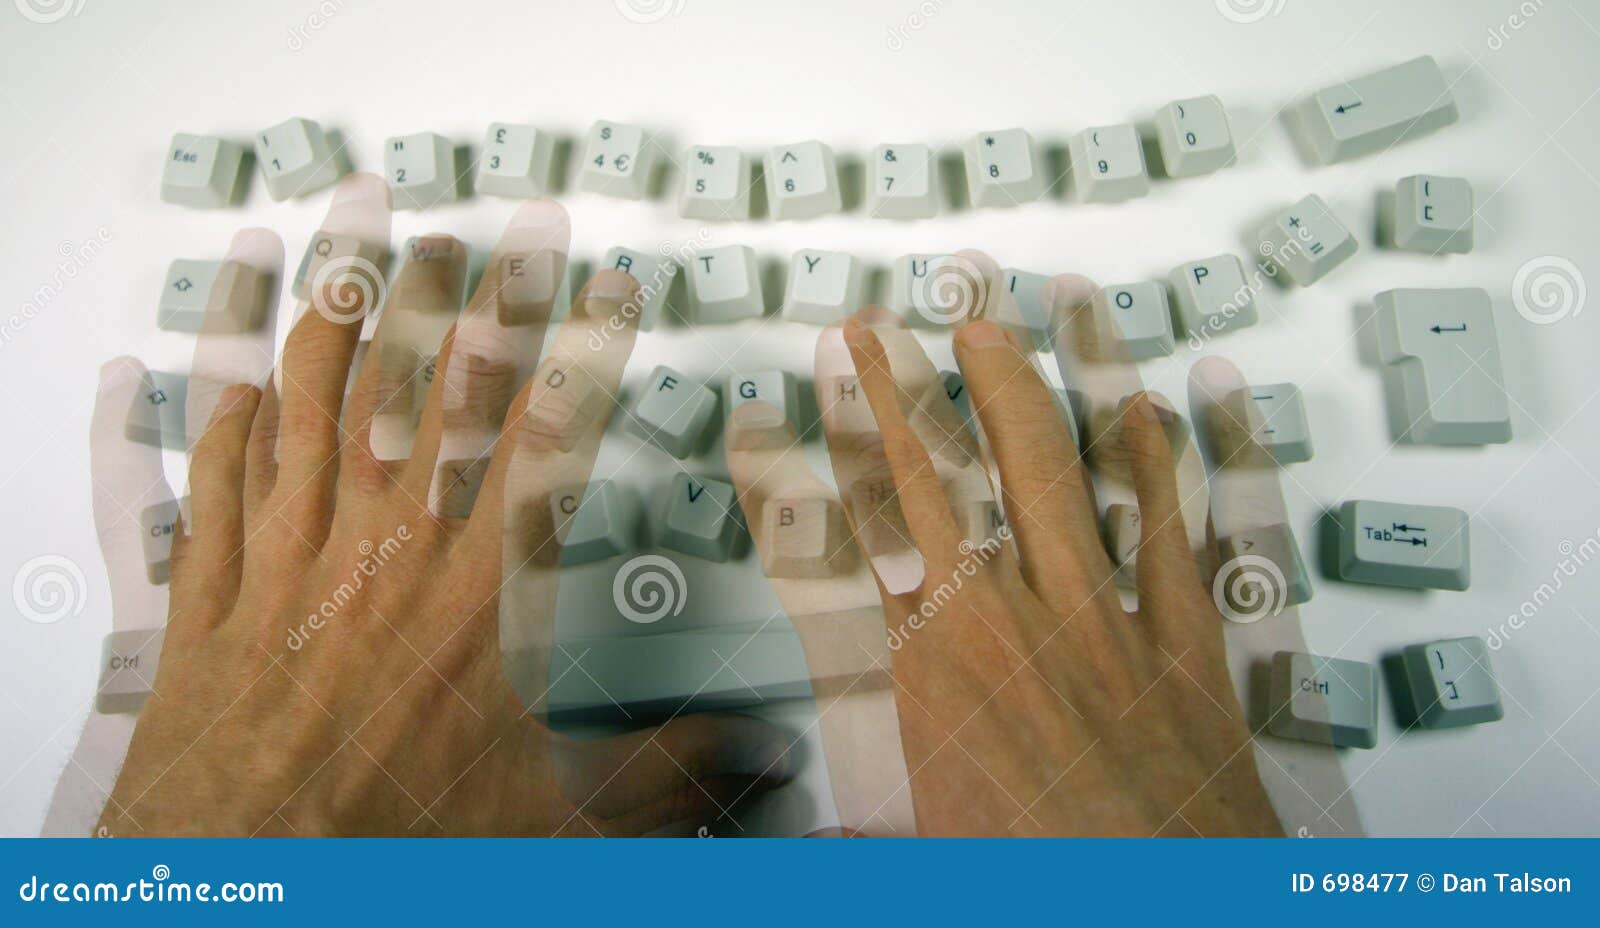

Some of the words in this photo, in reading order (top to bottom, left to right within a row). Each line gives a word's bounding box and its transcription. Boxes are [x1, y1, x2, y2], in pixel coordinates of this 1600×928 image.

[1177, 105, 1185, 119] )
[496, 129, 507, 144] £
[601, 127, 612, 140] $
[1092, 133, 1100, 146] (
[173, 150, 198, 164] Esc
[271, 158, 282, 171] 1
[490, 156, 500, 170] 3
[594, 154, 604, 167] 4
[614, 154, 629, 172] €
[697, 151, 715, 165] %
[884, 150, 897, 162] &
[989, 165, 999, 178] 8
[1098, 160, 1108, 173] 9
[396, 169, 406, 183] 2
[885, 177, 895, 191] 7
[696, 179, 705, 193] 5
[785, 179, 795, 192] 6
[1424, 205, 1433, 220] [
[315, 238, 333, 259] Q
[411, 244, 434, 262] W
[509, 259, 524, 276] E
[615, 255, 633, 273] R
[699, 256, 714, 273] T
[804, 256, 821, 274] Y
[912, 260, 927, 278] U
[1194, 266, 1209, 285] P
[1115, 291, 1133, 310] O
[545, 369, 565, 389] D
[657, 375, 678, 392] F
[739, 381, 757, 399] G
[840, 383, 857, 401] H
[451, 468, 468, 487] X
[688, 482, 703, 503] V
[560, 496, 577, 515] C
[780, 507, 794, 526] B
[1364, 527, 1393, 542] Tab
[110, 655, 138, 671] Ctrl
[1300, 677, 1329, 695] Ctrl
[1445, 681, 1458, 700] ]
